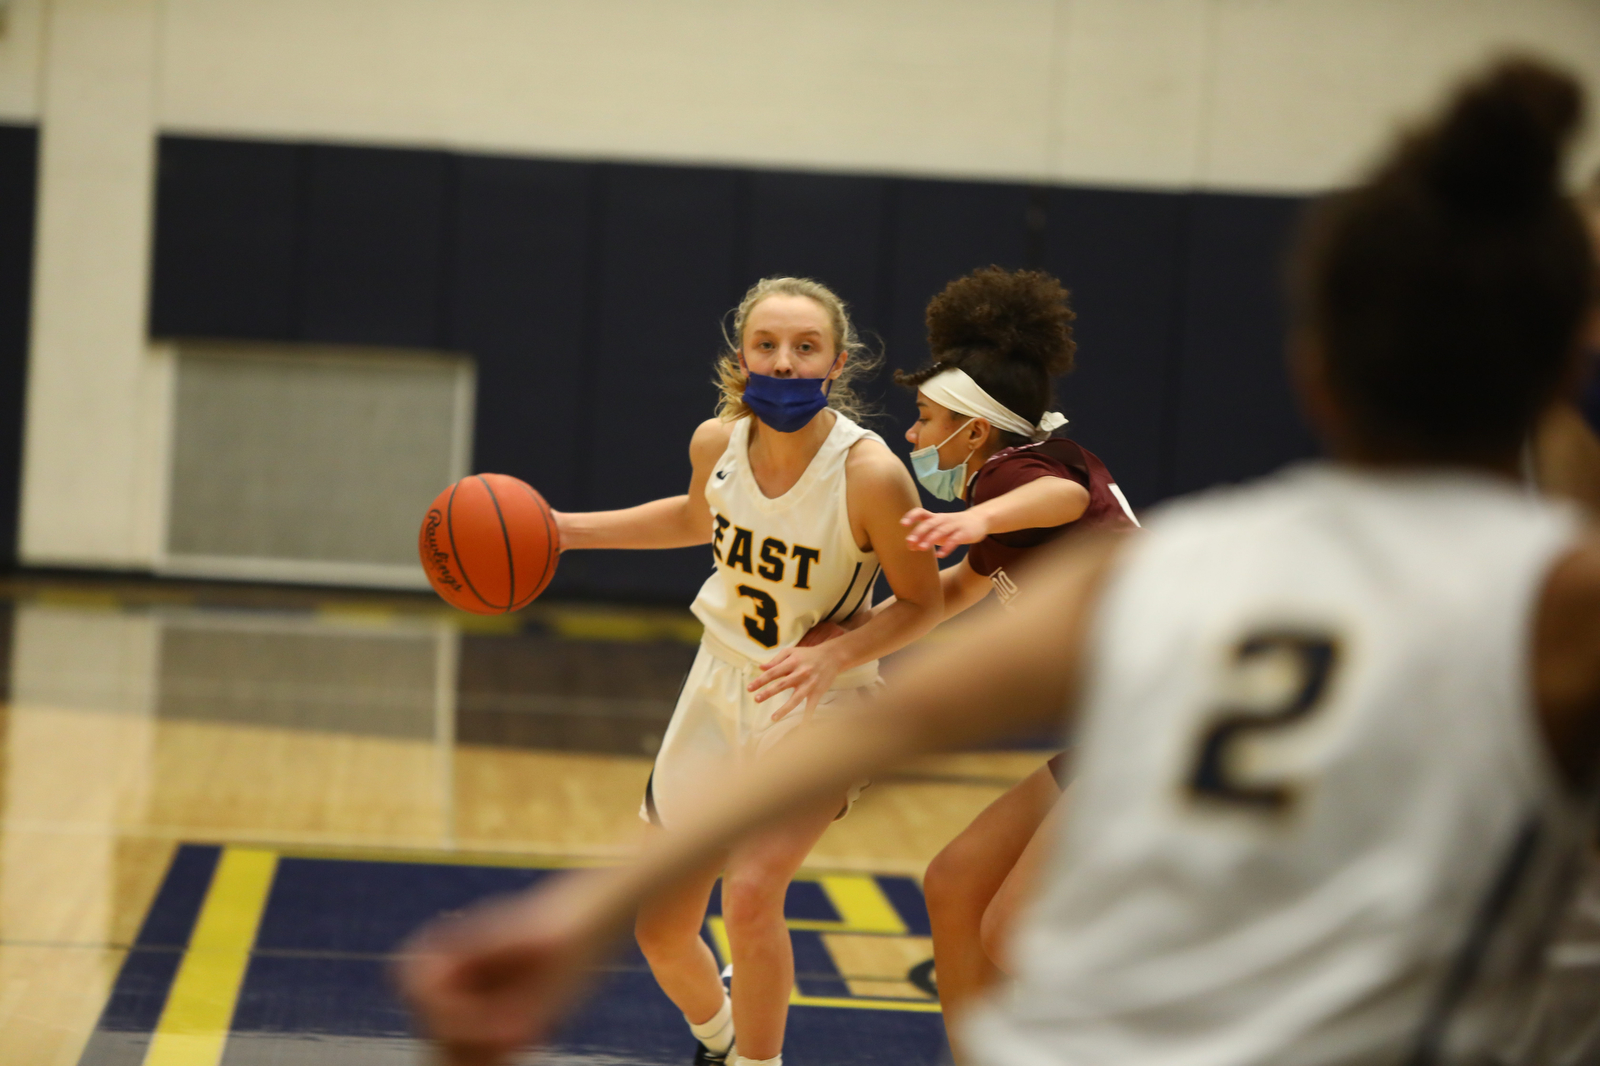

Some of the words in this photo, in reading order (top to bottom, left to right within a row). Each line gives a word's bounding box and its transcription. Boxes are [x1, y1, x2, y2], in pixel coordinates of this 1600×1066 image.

[425, 509, 462, 592] Rawlings
[713, 513, 821, 591] EAST
[736, 583, 780, 650] 3
[1181, 624, 1343, 816] 2
